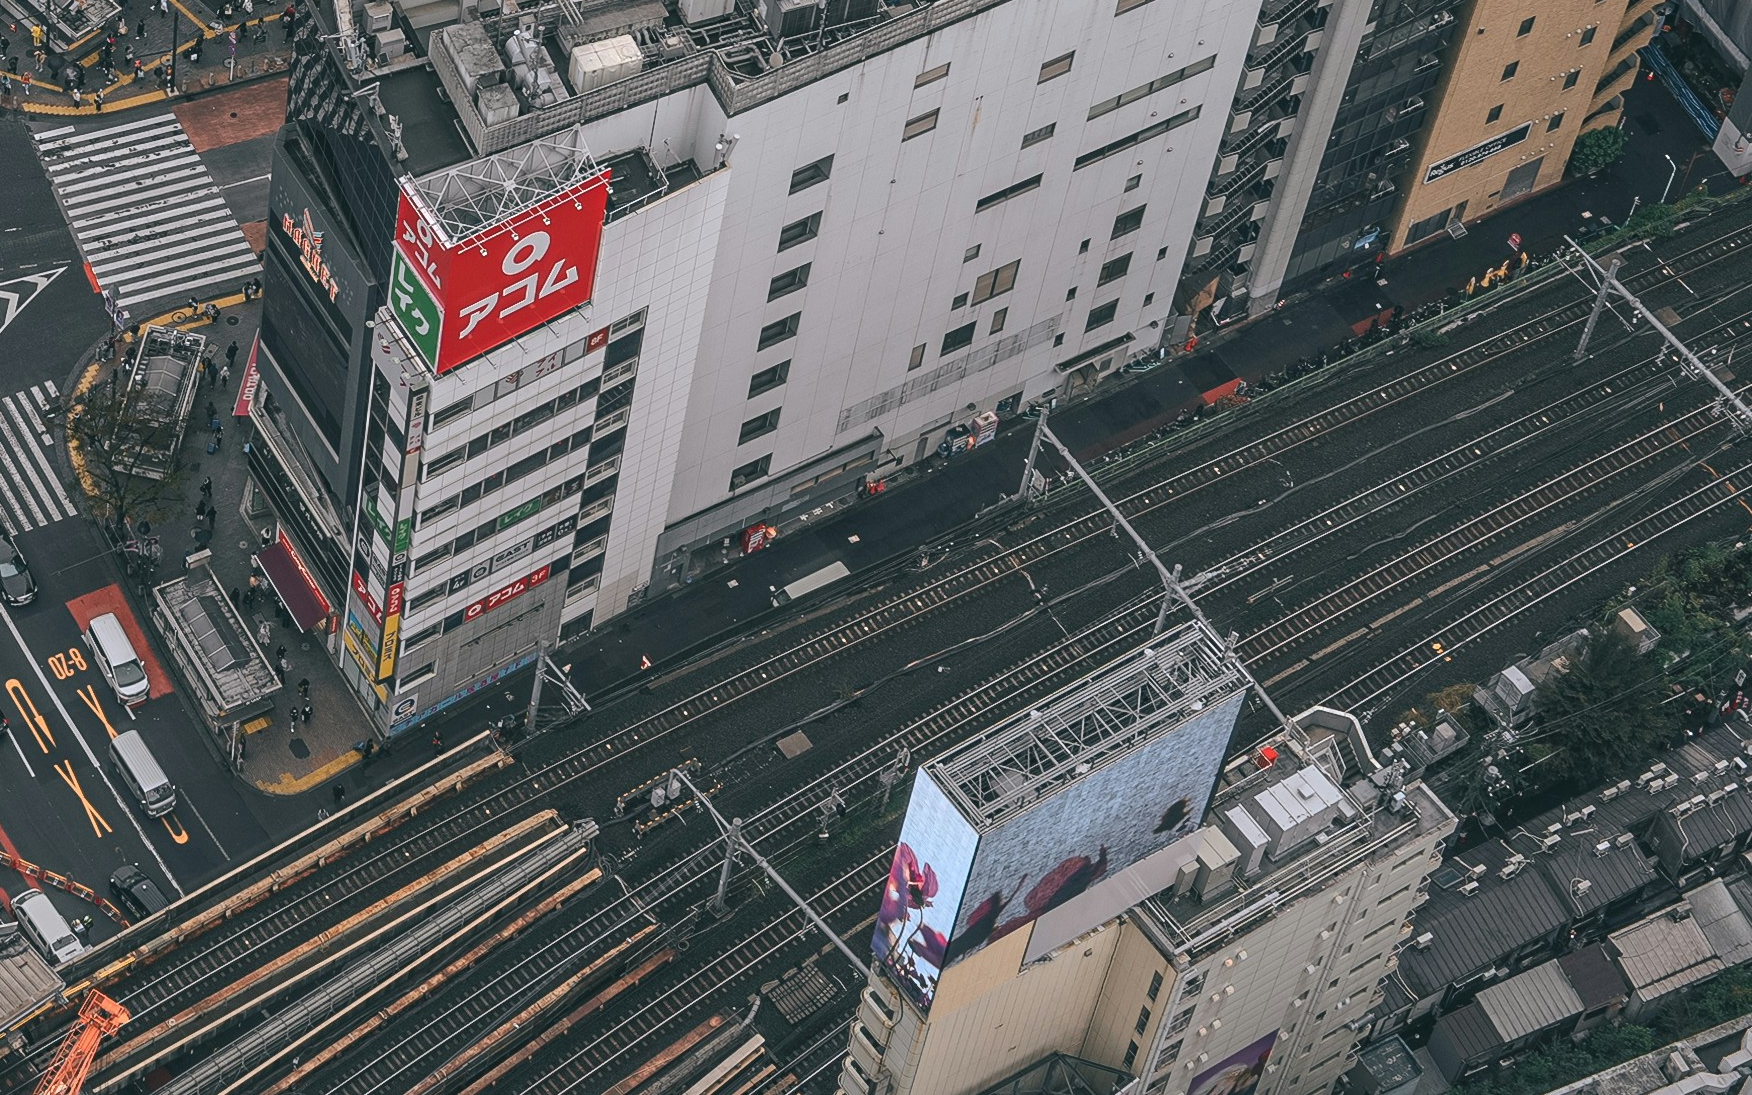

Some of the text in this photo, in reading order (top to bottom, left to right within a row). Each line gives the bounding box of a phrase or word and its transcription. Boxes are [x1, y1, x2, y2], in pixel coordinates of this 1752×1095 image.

[282, 212, 340, 303] MAGNET
[402, 219, 441, 290] アコム
[394, 259, 430, 336] レイク
[458, 258, 579, 339] アコム
[590, 333, 604, 346] 8F
[503, 503, 534, 523] レイク
[356, 579, 383, 625] アコム
[489, 569, 547, 607] アコム 3F
[48, 648, 87, 681] 8-20
